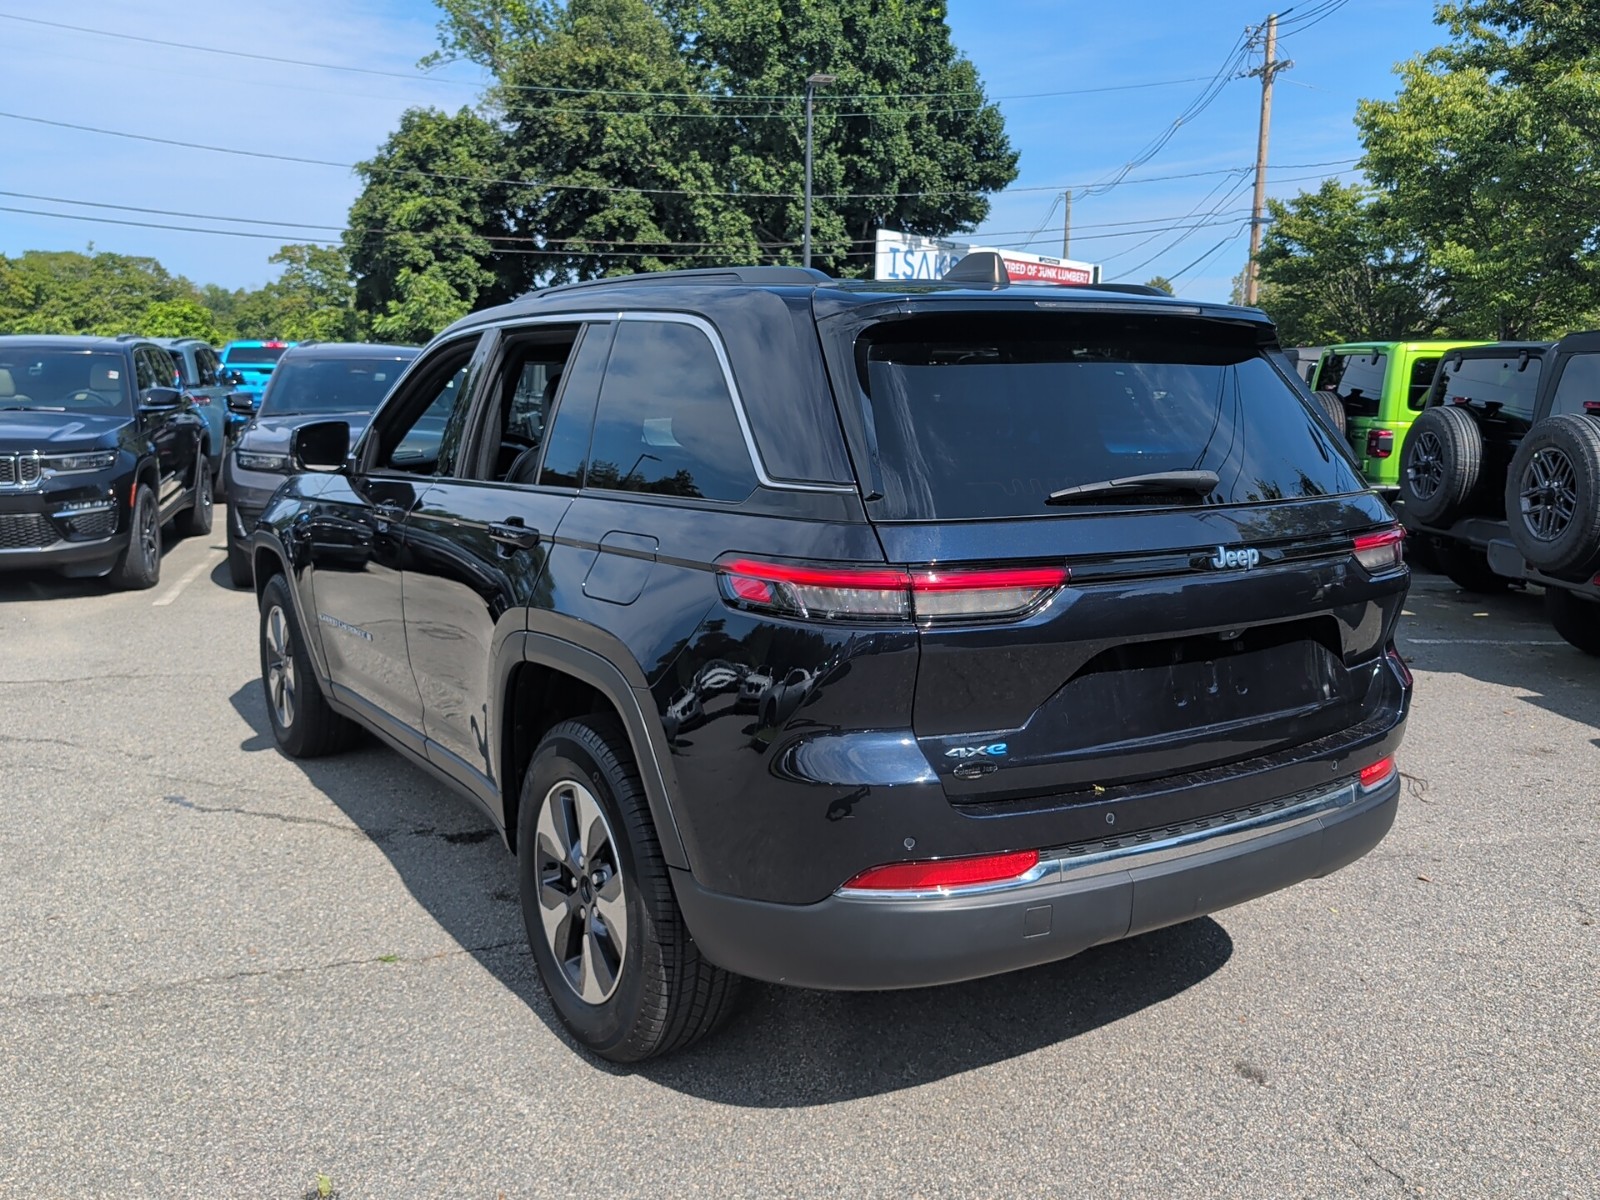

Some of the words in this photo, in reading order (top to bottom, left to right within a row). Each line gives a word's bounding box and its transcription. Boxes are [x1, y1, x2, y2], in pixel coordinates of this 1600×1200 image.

[1027, 265, 1038, 277] OF
[1038, 266, 1057, 279] JUNK
[1212, 546, 1260, 570] Jeep
